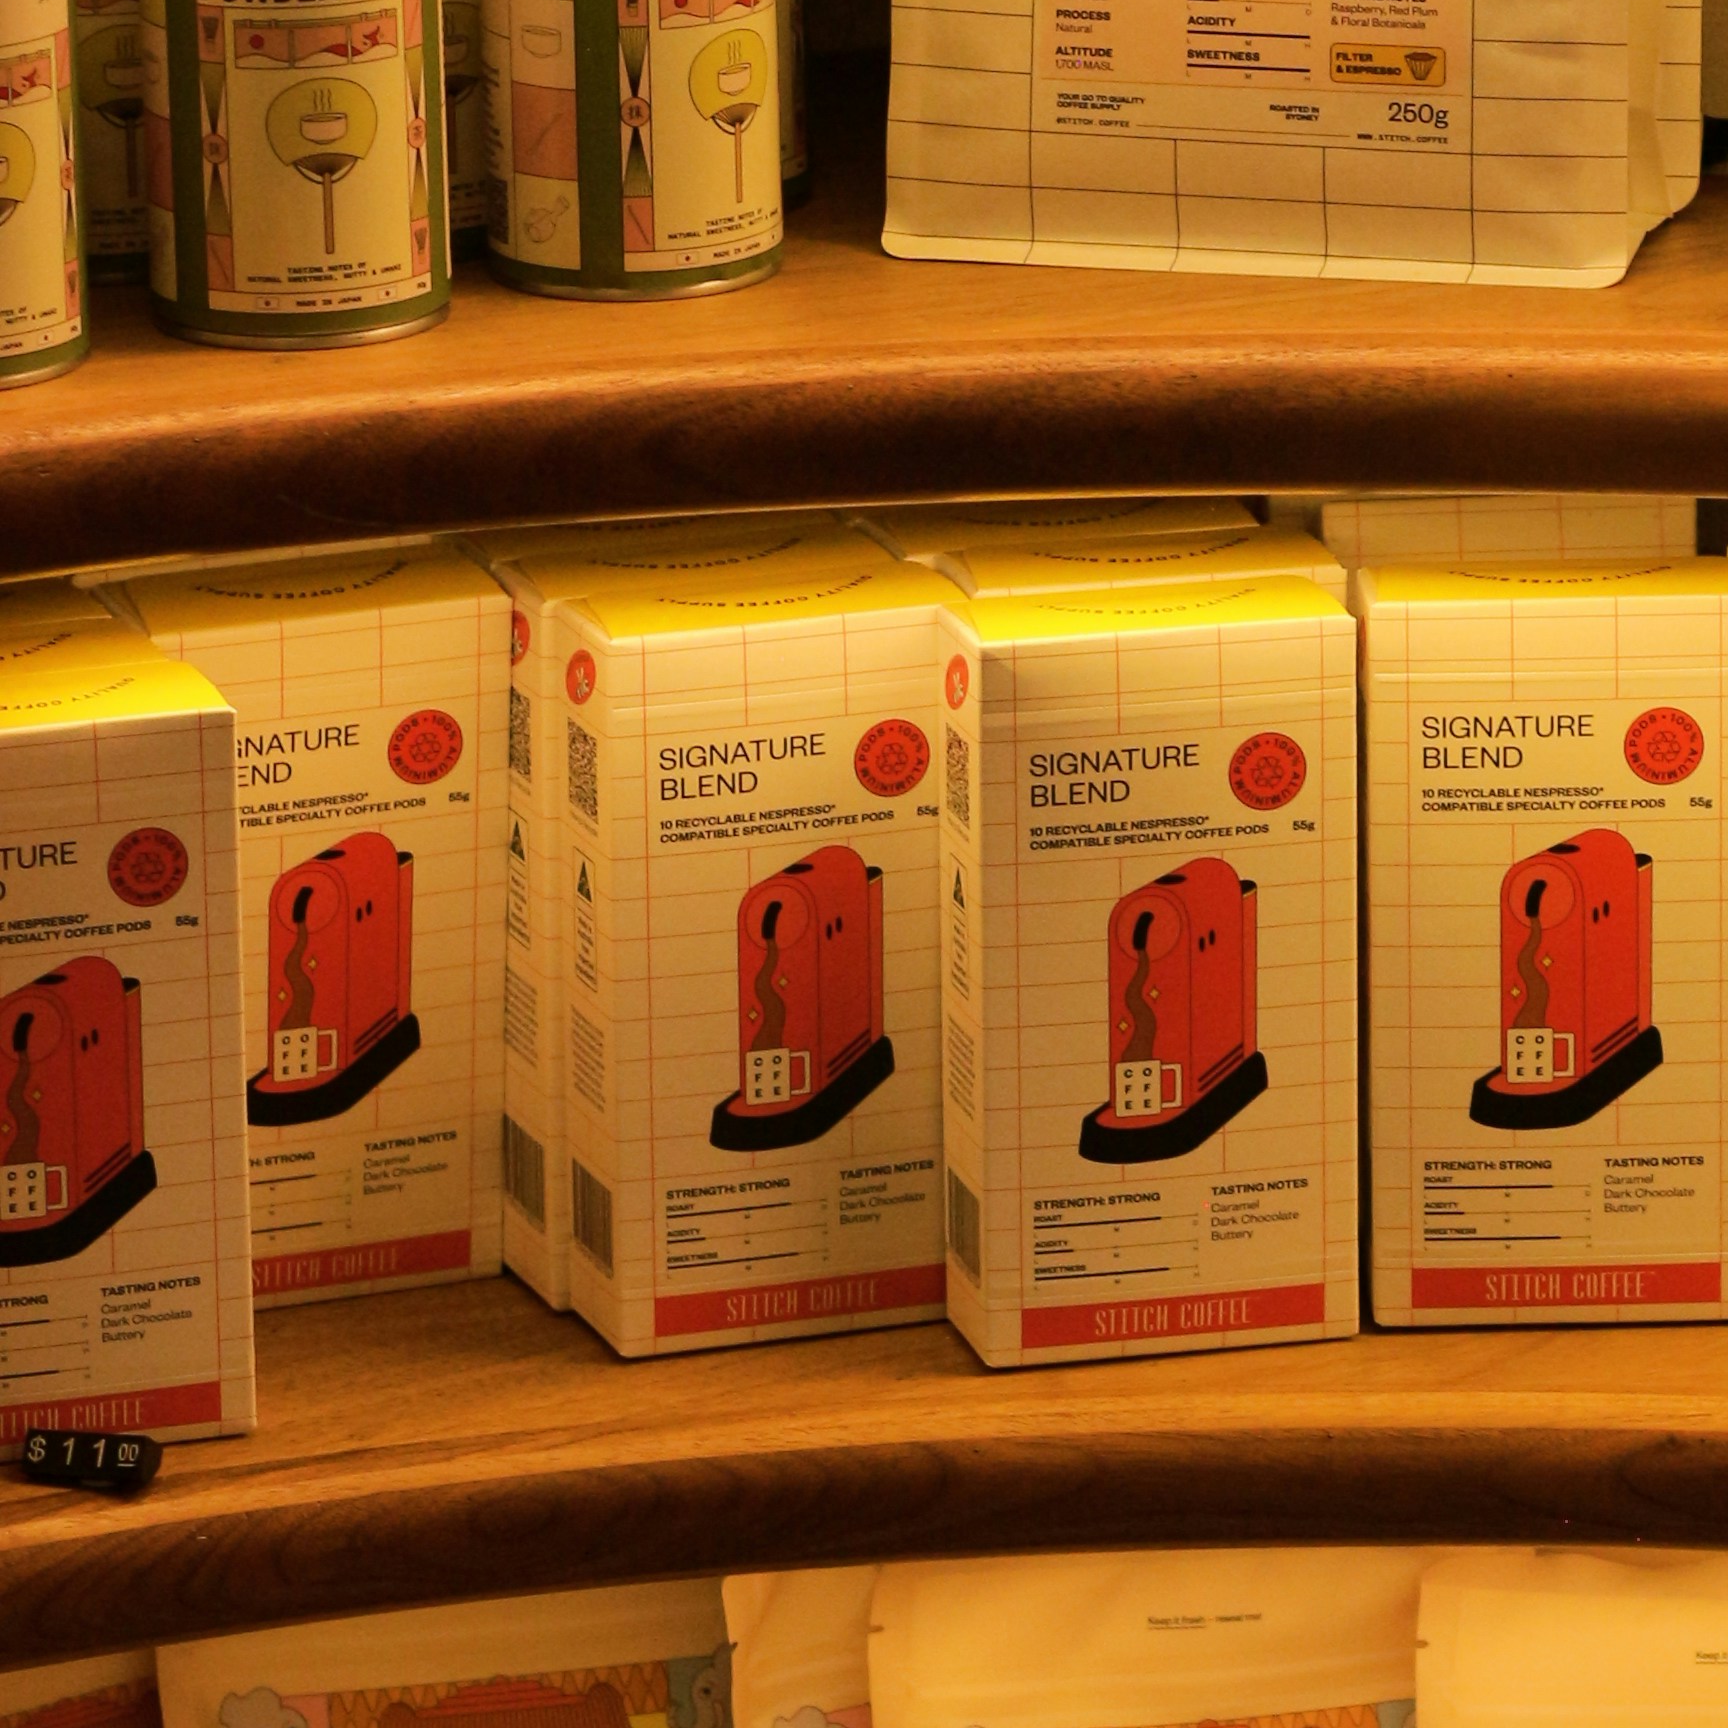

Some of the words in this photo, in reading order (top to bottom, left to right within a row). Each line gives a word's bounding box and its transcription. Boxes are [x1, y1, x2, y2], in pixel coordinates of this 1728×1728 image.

[1056, 9, 1111, 21] PROCESS
[1389, 4, 1410, 16] Red
[1412, 6, 1438, 17] Plum
[1187, 16, 1236, 27] ACIDITY
[1331, 16, 1339, 26] &
[1341, 16, 1370, 27] Floral
[1372, 18, 1427, 30] Botanicals
[1056, 23, 1093, 34] Natural
[1056, 46, 1113, 57] ALTITUDE
[1187, 49, 1260, 61] SWEETNESS
[1336, 52, 1373, 62] FILTER
[1083, 60, 1114, 71] MASL
[1345, 65, 1402, 76] ESPRESSO
[1388, 102, 1449, 129] 250g
[1422, 715, 1594, 739] SIGNATURE
[659, 733, 826, 771] SIGNATURE
[1422, 746, 1523, 770] BLEND
[1029, 744, 1200, 777] SIGNATURE
[660, 771, 758, 801] BLEND
[1030, 780, 1130, 808] BLEND
[1422, 789, 1434, 798] 10
[1437, 788, 1520, 799] RECYCLABLE
[1422, 801, 1504, 812] COMPATIBLE
[1507, 801, 1576, 812] SPECIALTY
[1579, 799, 1628, 810] COFFEE
[1632, 799, 1666, 808] PODS
[1689, 797, 1712, 809] 55g
[1424, 1161, 1496, 1171] STRENGTH:
[1499, 1160, 1552, 1170] STRONG
[1604, 1156, 1659, 1168] TASTING
[1662, 1156, 1704, 1166] NOTES
[1604, 1174, 1654, 1185] Caramel
[1604, 1188, 1633, 1198] Dark
[1635, 1187, 1695, 1197] Chocolate
[1604, 1202, 1647, 1213] Buttery
[1485, 1273, 1560, 1301] STITCH
[1573, 1271, 1647, 1298] COFFEE
